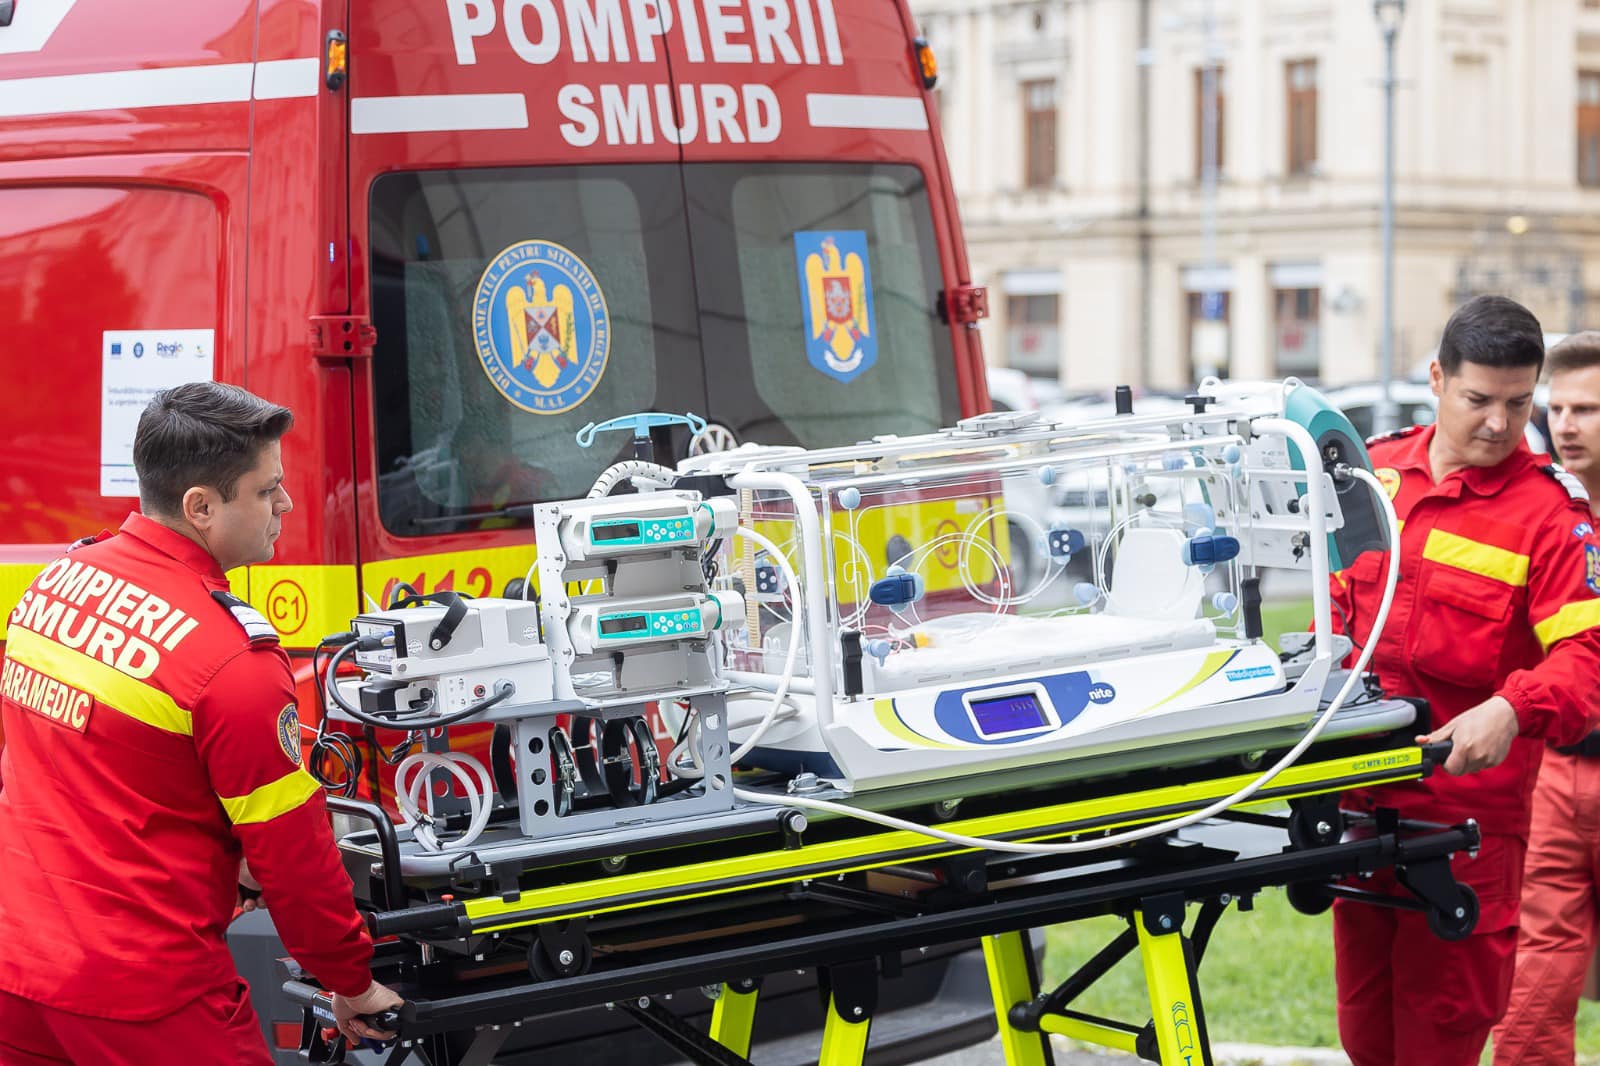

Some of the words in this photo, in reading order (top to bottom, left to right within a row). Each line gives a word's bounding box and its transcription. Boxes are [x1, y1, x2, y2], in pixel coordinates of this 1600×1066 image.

[445, 0, 844, 66] POMPIERII
[557, 82, 783, 147] SMURD
[12, 590, 161, 680] SMURD
[272, 596, 300, 621] C1
[2, 659, 90, 729] PARAMEDIC
[1089, 690, 1113, 701] nite
